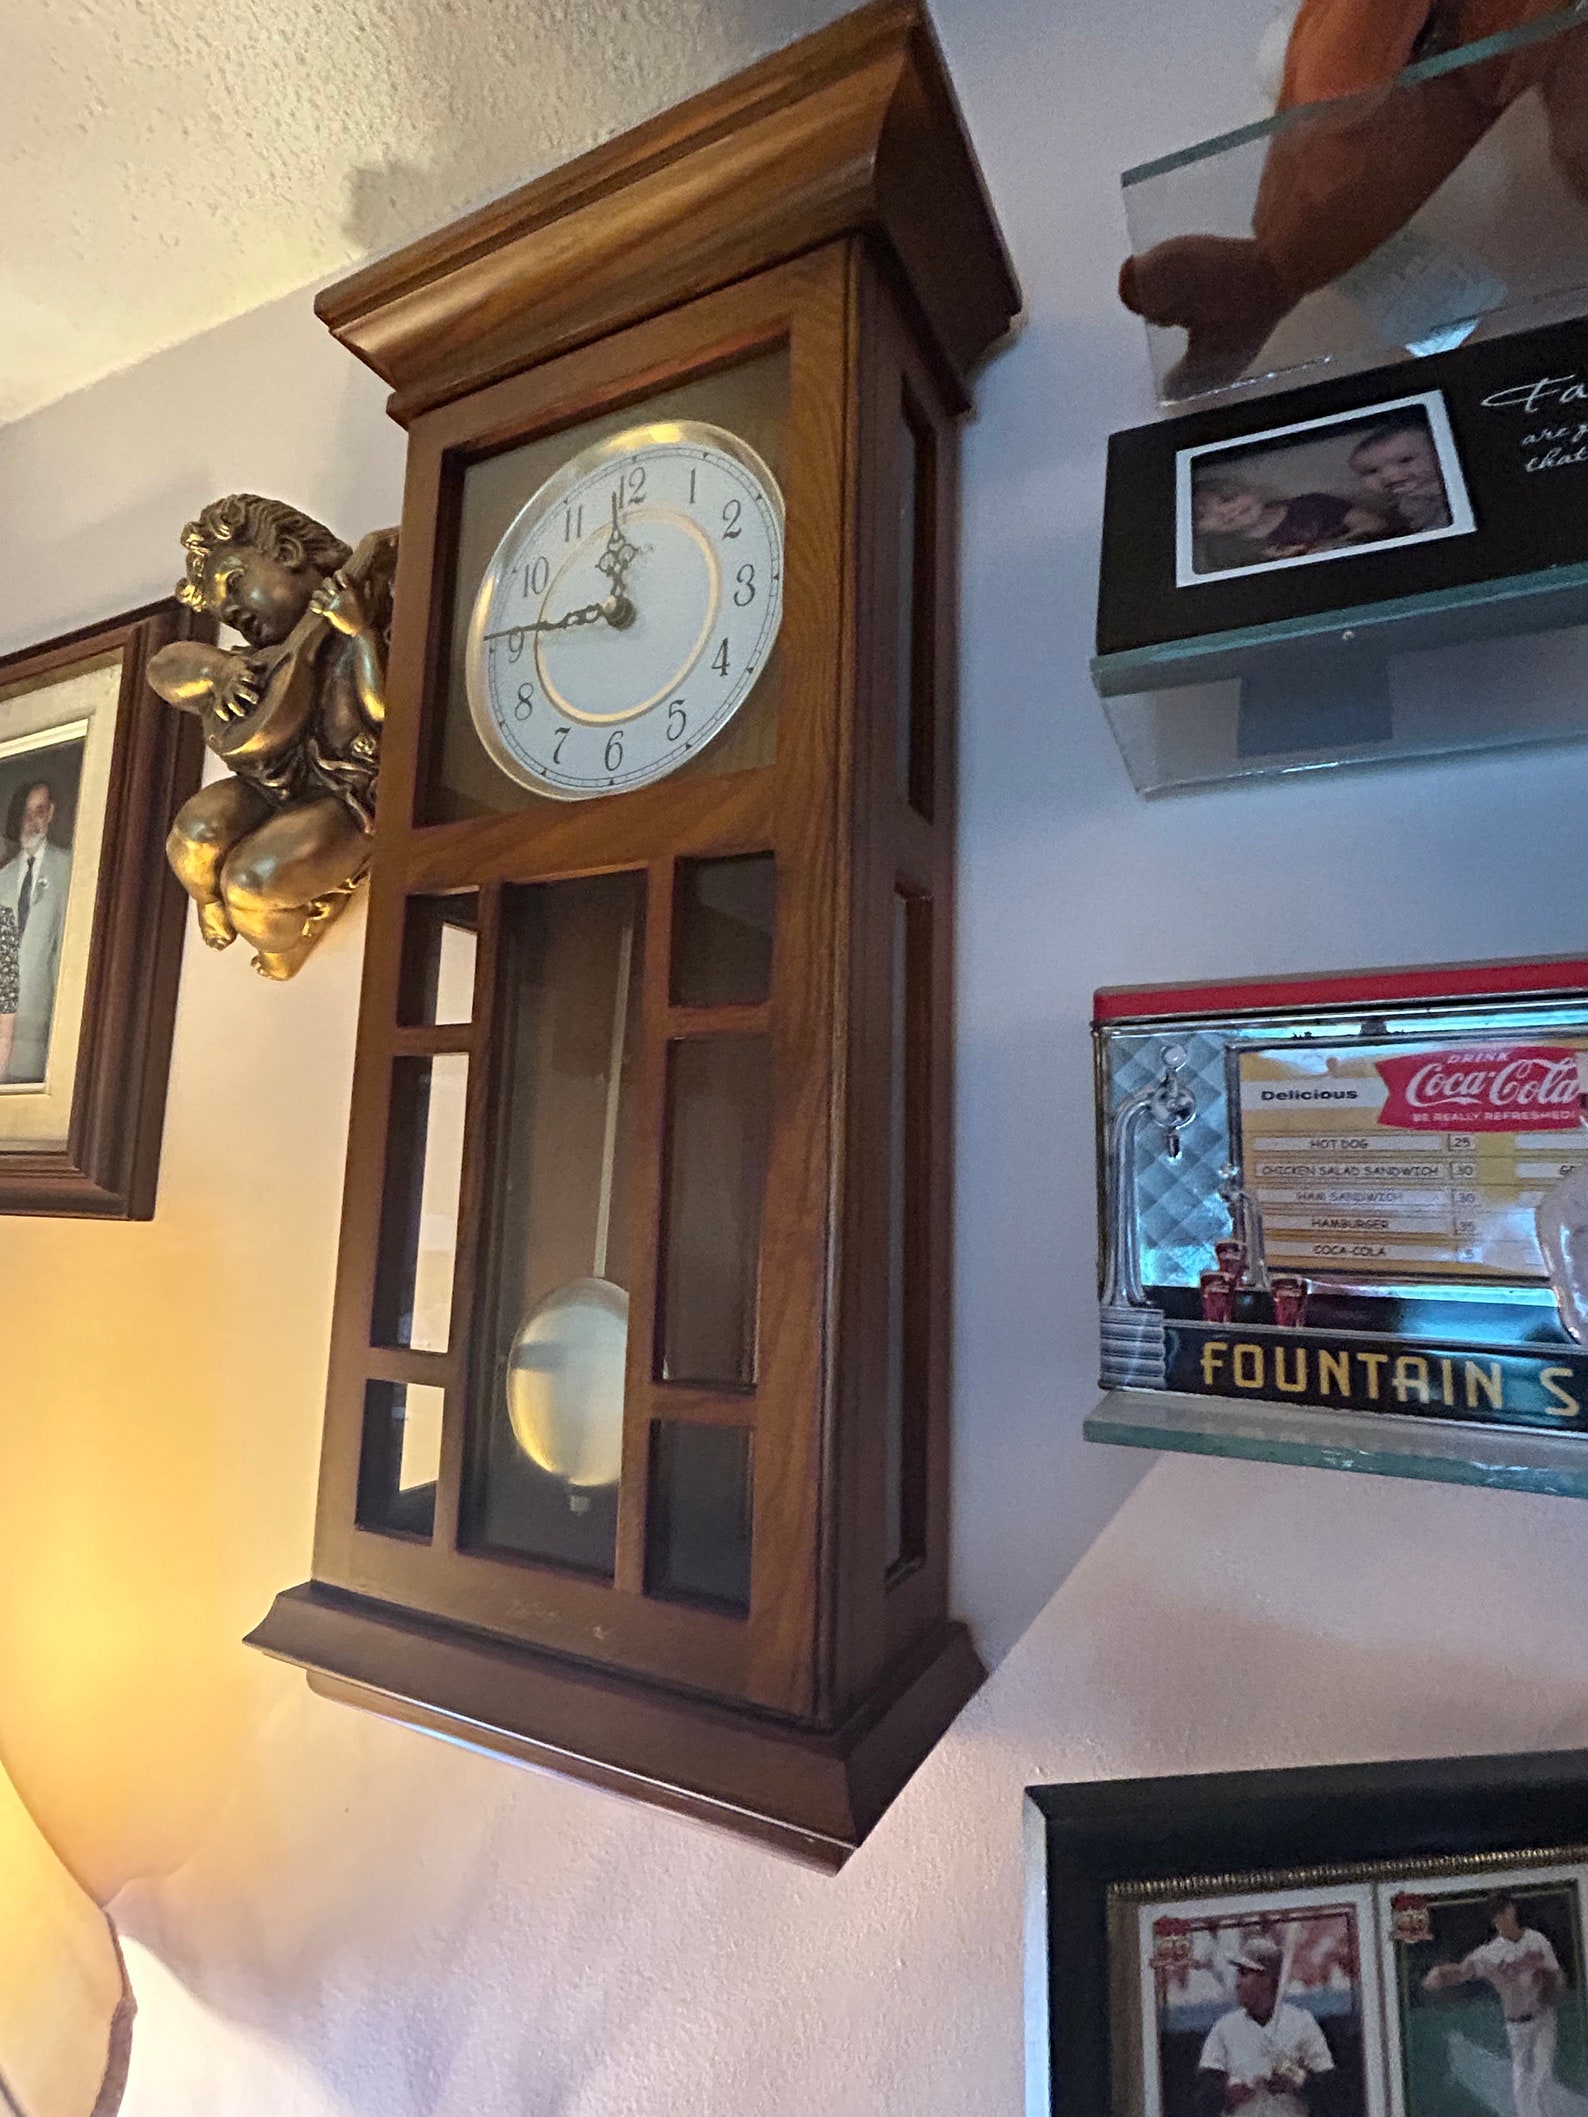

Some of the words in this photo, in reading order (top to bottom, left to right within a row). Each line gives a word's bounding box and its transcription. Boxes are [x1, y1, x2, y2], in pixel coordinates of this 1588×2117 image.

[618, 466, 647, 508] 12
[689, 467, 697, 504] 1
[565, 504, 583, 542] 11
[722, 499, 742, 540] 2
[523, 556, 549, 597] 10
[733, 563, 756, 606] 3
[508, 626, 525, 663] 9
[711, 637, 731, 676] 4
[514, 683, 535, 720] 8
[667, 699, 686, 741] 5
[553, 727, 571, 765] 7
[604, 730, 624, 771] 6
[1446, 1051, 1510, 1064] DRINK
[1261, 1089, 1359, 1101] Delicious
[1405, 1057, 1581, 1107] Coca-Cola
[1412, 1112, 1431, 1122] BE
[1433, 1111, 1480, 1122] REALLY
[1310, 1138, 1338, 1149] HOT
[1342, 1138, 1368, 1149] DOG
[1262, 1165, 1316, 1176] CHICKEN
[1320, 1165, 1359, 1177] SALAD
[1363, 1165, 1439, 1177] SANDWICH
[1296, 1191, 1326, 1201] HAM
[1330, 1192, 1403, 1203] SANDWICH
[1311, 1218, 1390, 1229] HAMBURGER
[1314, 1245, 1387, 1257] COCA-COLA
[1200, 1341, 1503, 1410] FOUNTAIN
